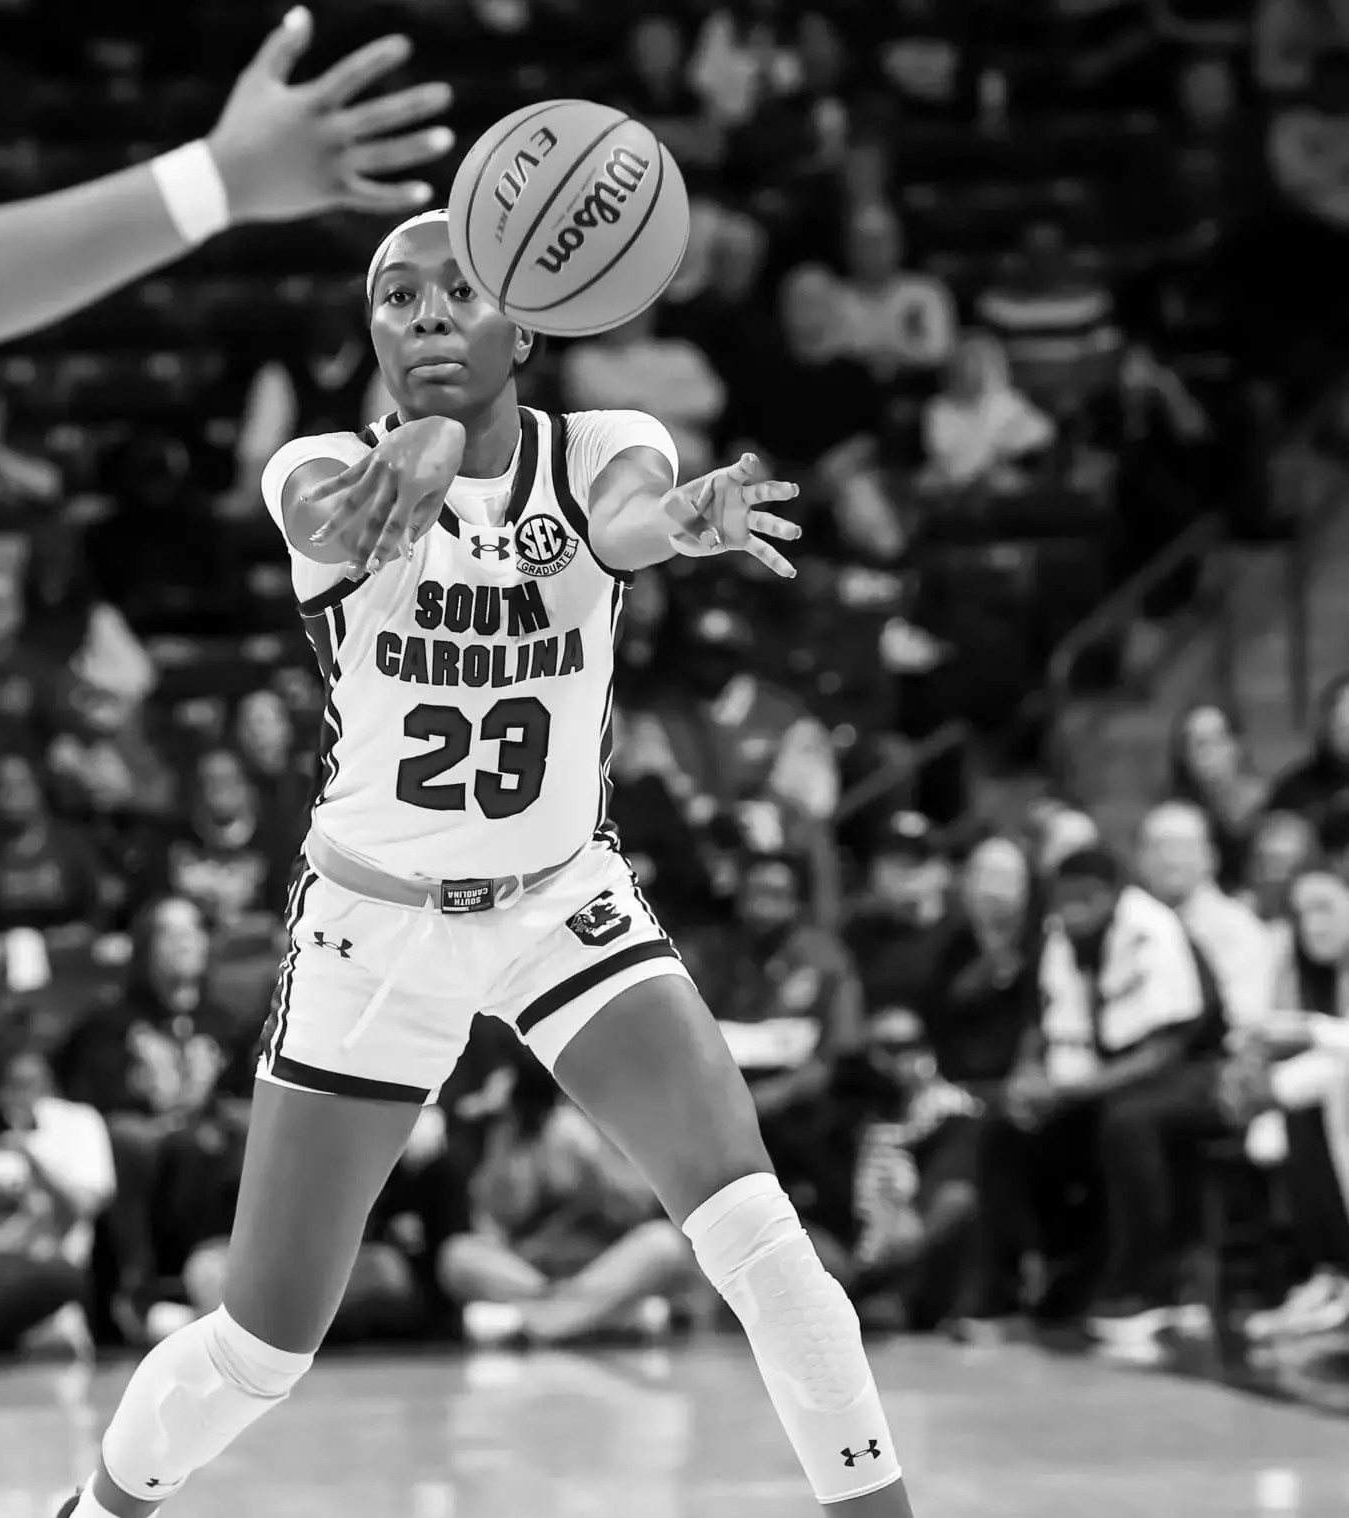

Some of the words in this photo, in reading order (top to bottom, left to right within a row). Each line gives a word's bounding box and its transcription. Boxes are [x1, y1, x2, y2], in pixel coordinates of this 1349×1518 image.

[534, 147, 650, 274] Wilson
[519, 517, 562, 561] SEC
[520, 549, 574, 576] GRADUATE
[376, 627, 584, 688] CAROLINA
[396, 696, 552, 819] 23
[447, 887, 489, 899] CAROLINA
[454, 896, 482, 906] SOUTH
